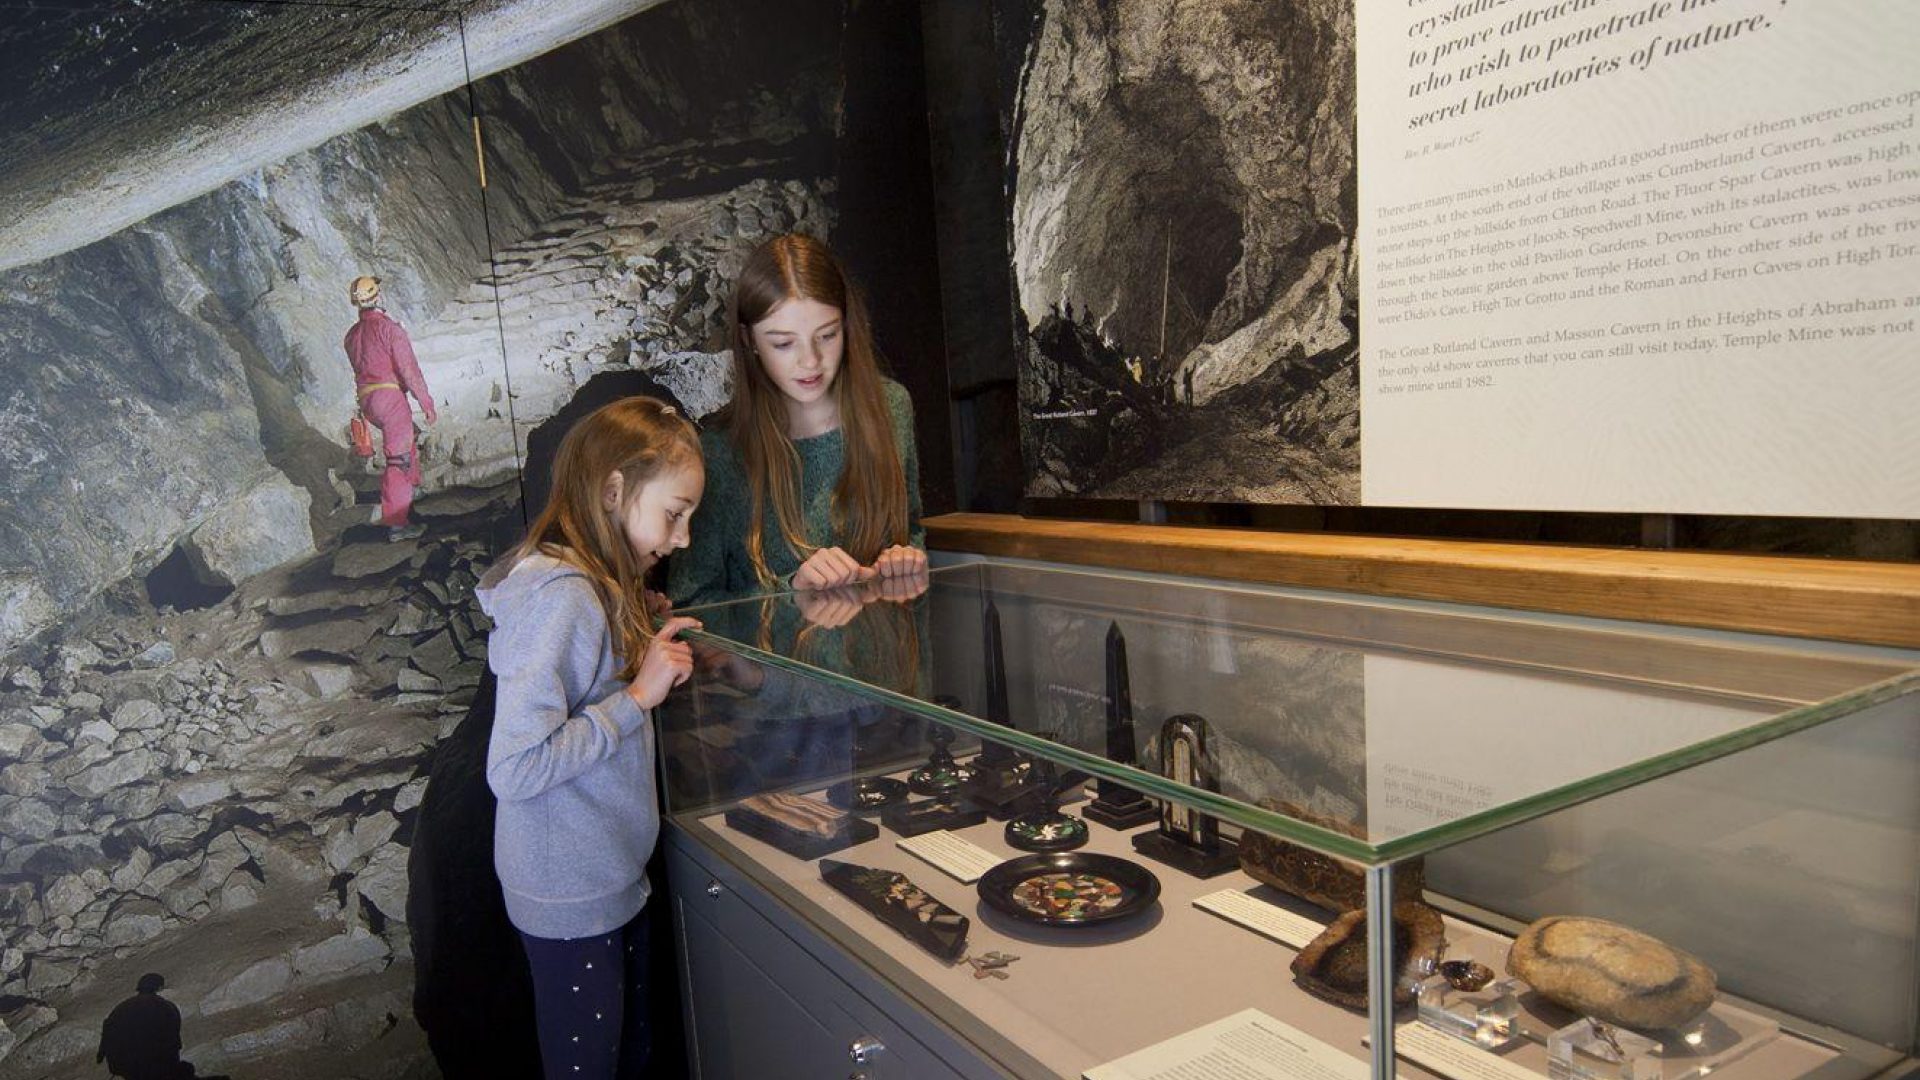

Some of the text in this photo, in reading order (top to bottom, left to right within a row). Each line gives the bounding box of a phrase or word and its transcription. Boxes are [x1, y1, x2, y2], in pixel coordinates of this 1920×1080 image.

[1408, 14, 1771, 129] secret laboratories of nature.
[1409, 51, 1427, 68] to
[1432, 27, 1494, 66] prove
[1409, 72, 1452, 97] who
[1459, 48, 1512, 82] wish
[1519, 44, 1541, 62] to
[1546, 1, 1672, 62] penetrate
[1407, 235, 1433, 249] steps
[1436, 232, 1450, 245] up
[1453, 226, 1470, 239] the
[1474, 217, 1516, 235] hillside
[1520, 213, 1548, 227] from
[1552, 204, 1596, 220] Clifton
[1643, 188, 1670, 203] The
[1674, 182, 1713, 198] Fluor
[1719, 174, 1754, 192] Spar
[1760, 162, 1821, 181] Cavern
[1827, 154, 1862, 169] was
[1867, 140, 1910, 163] high
[1424, 194, 1452, 208] many
[1456, 186, 1490, 201] mines
[1492, 181, 1504, 193] in
[1507, 167, 1556, 190] Matlock
[1559, 160, 1588, 178] Bath
[1591, 154, 1616, 171] and
[1619, 155, 1627, 165] a
[1630, 143, 1666, 167] good
[1670, 133, 1728, 154] number
[1732, 125, 1749, 140] of
[1752, 118, 1796, 136] them
[1800, 108, 1843, 125] were
[1847, 97, 1891, 115] once
[1434, 212, 1446, 225] At
[1449, 208, 1468, 222] the
[1472, 199, 1504, 217] south
[1507, 194, 1530, 210] end
[1534, 190, 1548, 204] of
[1552, 186, 1573, 201] the
[1577, 178, 1621, 196] village
[1626, 172, 1653, 185] was
[1658, 147, 1754, 179] Cumberland
[1832, 114, 1914, 143] accessed
[1377, 259, 1394, 272] the
[1396, 252, 1431, 268] hillside
[1434, 250, 1445, 262] in
[1447, 245, 1468, 259] The
[1471, 238, 1515, 256] Heights
[1518, 233, 1530, 247] of
[1572, 213, 1641, 240] Speedwell
[1690, 199, 1725, 217] with
[1730, 197, 1749, 210] its
[1846, 175, 1882, 190] was
[1887, 169, 1920, 183] low
[1409, 271, 1426, 284] the
[1429, 265, 1468, 281] hillside
[1472, 263, 1483, 275] in
[1487, 259, 1506, 272] the
[1509, 254, 1529, 269] old
[1534, 248, 1583, 265] Pavilion
[1656, 222, 1744, 246] Devonshire
[1749, 213, 1808, 231] Cavern
[1815, 206, 1850, 220] was
[1377, 290, 1417, 308] through
[1420, 288, 1438, 301] the
[1441, 281, 1483, 298] botanic
[1487, 276, 1528, 295] garden
[1531, 271, 1569, 285] above
[1573, 261, 1621, 279] Temple
[1675, 250, 1700, 264] On
[1707, 245, 1732, 259] the
[1738, 239, 1781, 255] other
[1789, 232, 1823, 248] side
[1831, 227, 1849, 242] of
[1857, 223, 1886, 238] the
[1377, 314, 1401, 325] were
[1472, 297, 1501, 315] High
[1525, 291, 1567, 305] Grotto
[1569, 284, 1594, 300] and
[1597, 282, 1620, 296] the
[1624, 277, 1675, 292] Roman
[1678, 269, 1708, 285] and
[1713, 267, 1748, 281] Fern
[1753, 261, 1801, 276] Caves
[1806, 257, 1830, 269] on
[1836, 247, 1881, 267] High
[1378, 347, 1397, 359] The
[1400, 344, 1430, 357] Great
[1433, 338, 1477, 354] Rutland
[1479, 337, 1522, 349] Cavern
[1526, 330, 1549, 344] and
[1554, 328, 1605, 341] Masson
[1610, 323, 1660, 336] Cavern
[1666, 318, 1680, 331] in
[1686, 315, 1712, 329] the
[1717, 308, 1782, 327] Heights
[1787, 304, 1804, 319] of
[1810, 298, 1896, 316] Abraham
[1378, 365, 1395, 377] the
[1397, 363, 1419, 378] only
[1422, 360, 1440, 373] old
[1443, 359, 1473, 372] show
[1475, 357, 1521, 369] caverns
[1524, 352, 1548, 365] that
[1552, 352, 1577, 366] you
[1580, 349, 1604, 360] can
[1607, 343, 1633, 357] still
[1638, 340, 1669, 355] visit
[1722, 331, 1782, 349] Temple
[1788, 327, 1834, 342] Mine
[1839, 326, 1876, 338] was
[1882, 320, 1914, 334] not
[1378, 382, 1404, 394] show
[1406, 379, 1434, 392] mine
[1437, 376, 1462, 390] until
